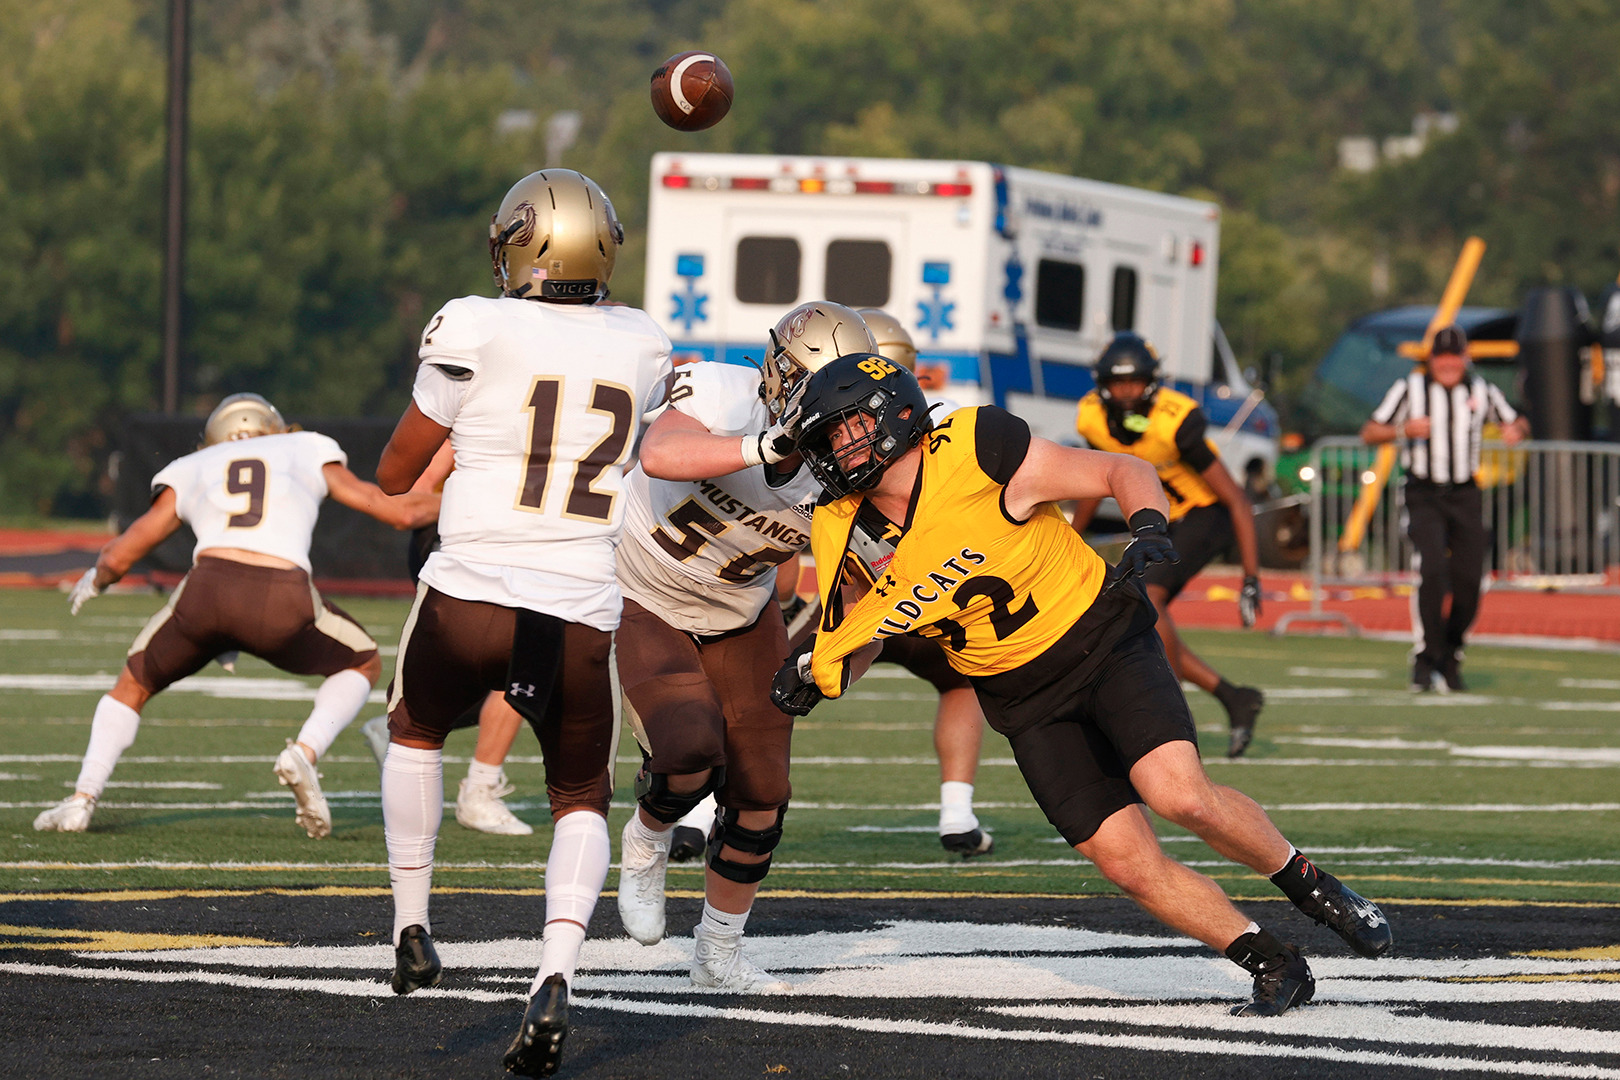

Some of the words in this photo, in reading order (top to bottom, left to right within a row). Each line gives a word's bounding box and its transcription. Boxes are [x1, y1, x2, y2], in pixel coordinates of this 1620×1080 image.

[551, 284, 591, 294] VICIS
[857, 356, 897, 381] 92
[513, 374, 636, 525] 12
[223, 458, 270, 532] 9
[792, 504, 814, 521] adida
[869, 547, 987, 643] ILDCATS
